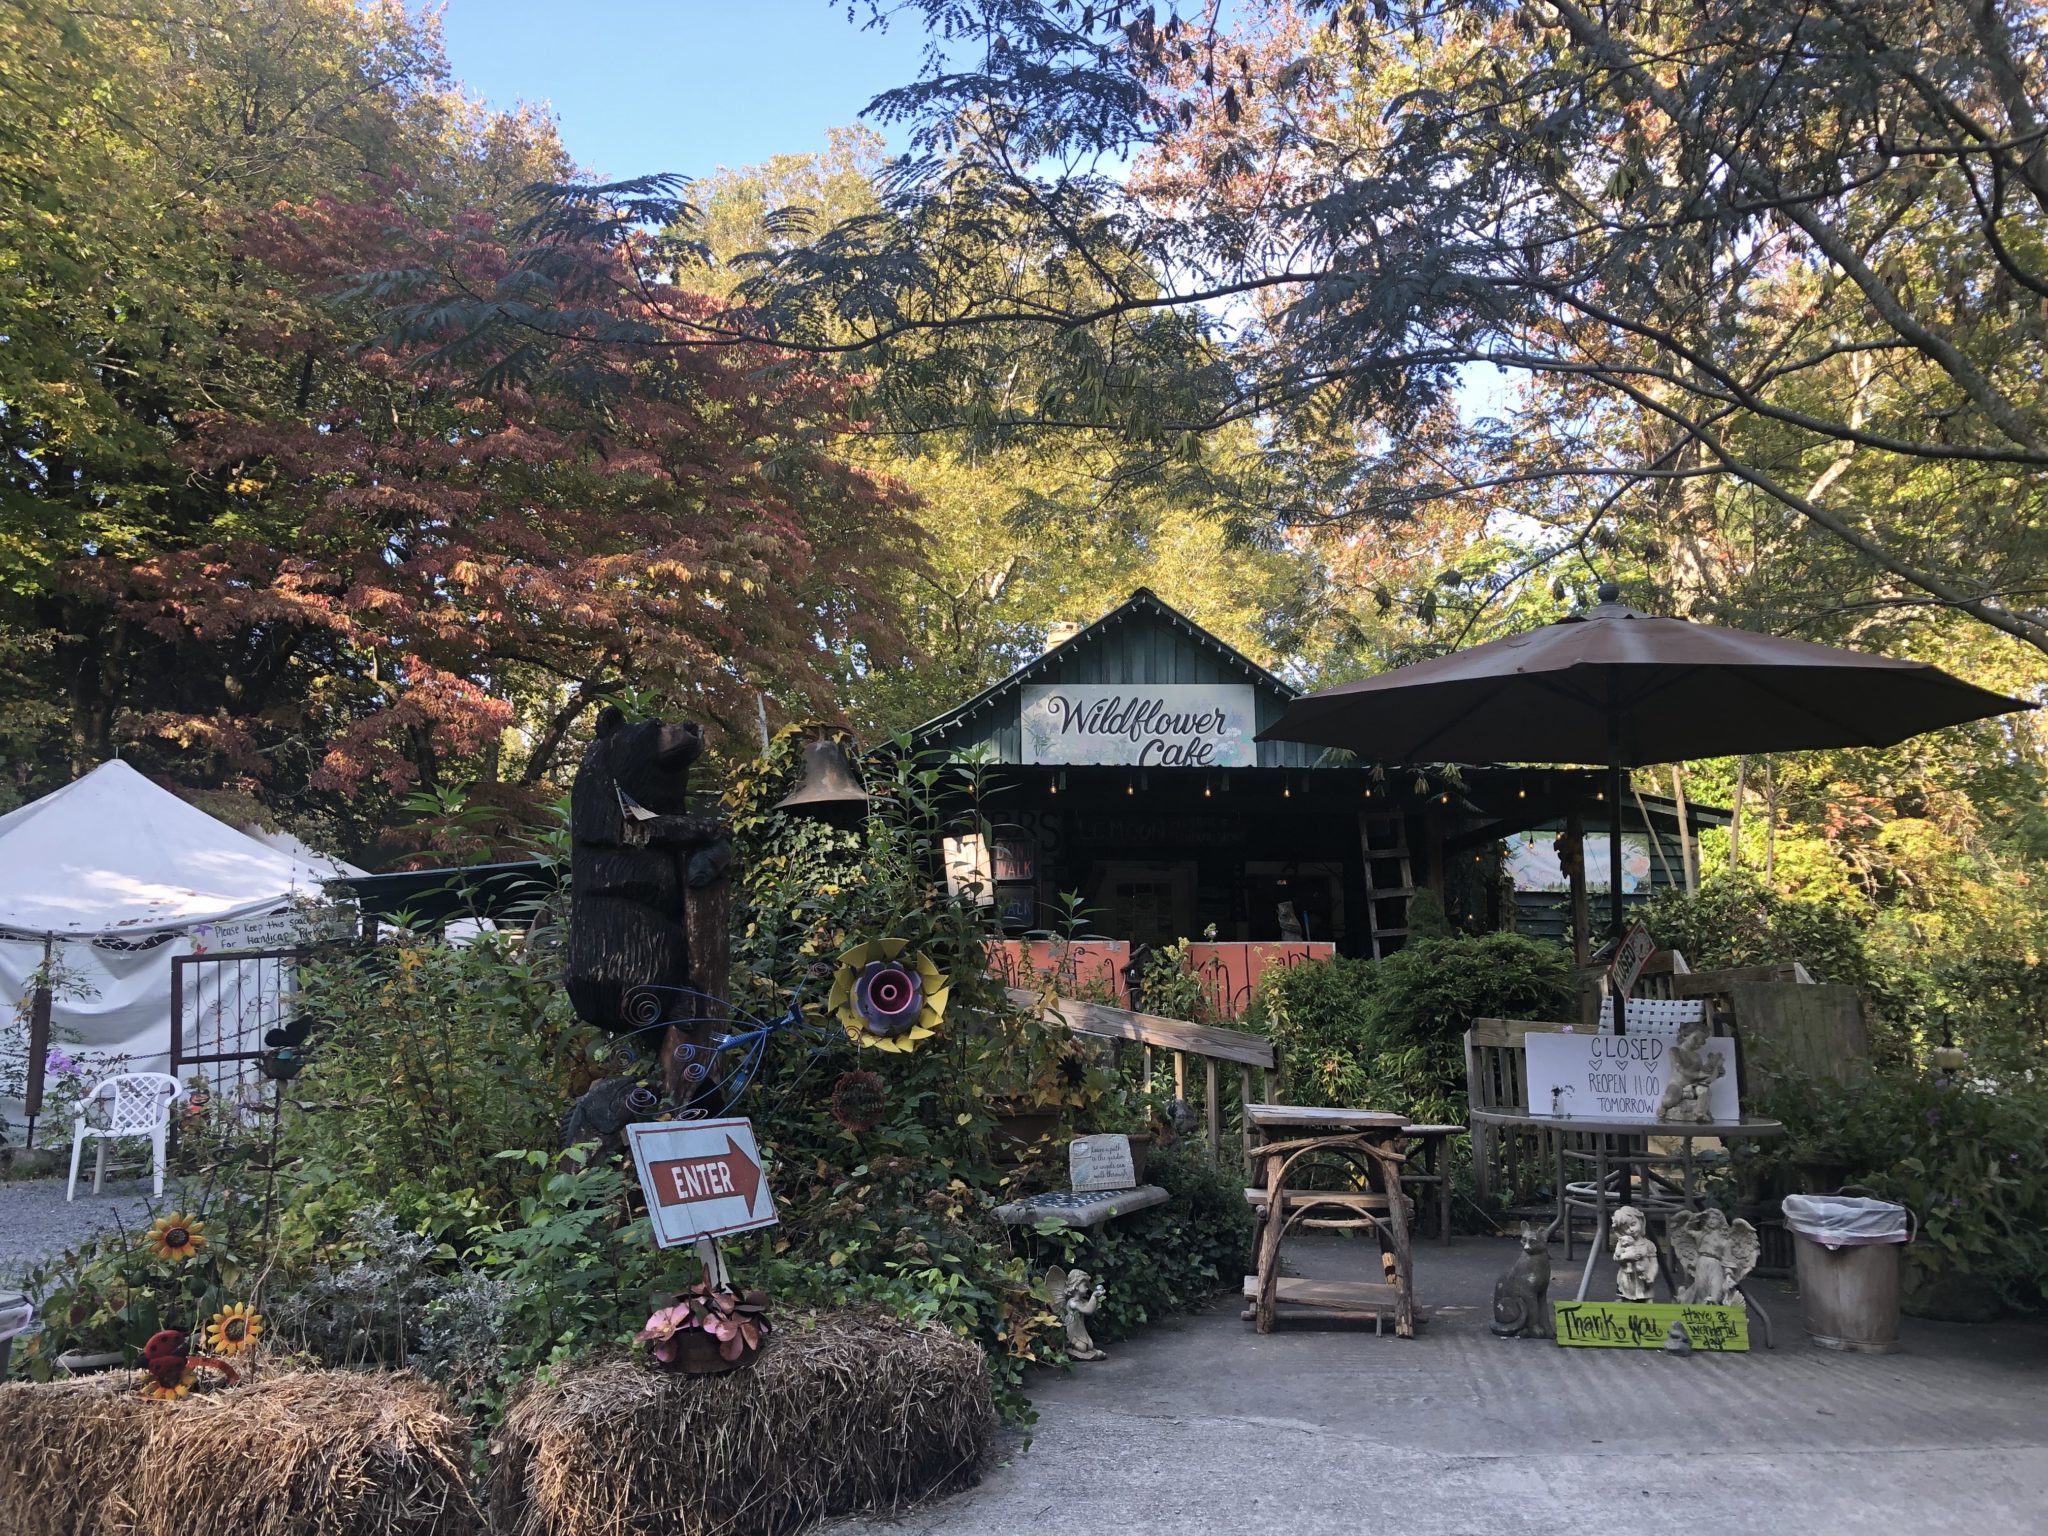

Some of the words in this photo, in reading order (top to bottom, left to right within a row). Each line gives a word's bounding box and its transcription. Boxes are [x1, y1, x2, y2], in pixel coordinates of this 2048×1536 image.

[1047, 695, 1226, 743] Wildflower
[1138, 736, 1216, 767] Cafe
[996, 861, 1032, 879] WALK
[998, 896, 1032, 916] ALK
[214, 924, 240, 939] Please
[266, 920, 285, 930] this
[289, 916, 310, 927] spac
[246, 932, 290, 945] Handicap
[1612, 942, 1637, 992] CLOSED
[1590, 1037, 1663, 1061] CLOSED
[1588, 1073, 1627, 1094] REOPEN
[1634, 1075, 1660, 1096] 11:00
[1596, 1097, 1655, 1114] TOMORROW
[1107, 1153, 1124, 1162] garden
[671, 1161, 735, 1200] ENTER
[1557, 1305, 1626, 1342] Thank
[1628, 1313, 1664, 1346] you
[1682, 1306, 1712, 1323] Have
[1715, 1309, 1729, 1323] a
[1688, 1321, 1739, 1338] wonderful
